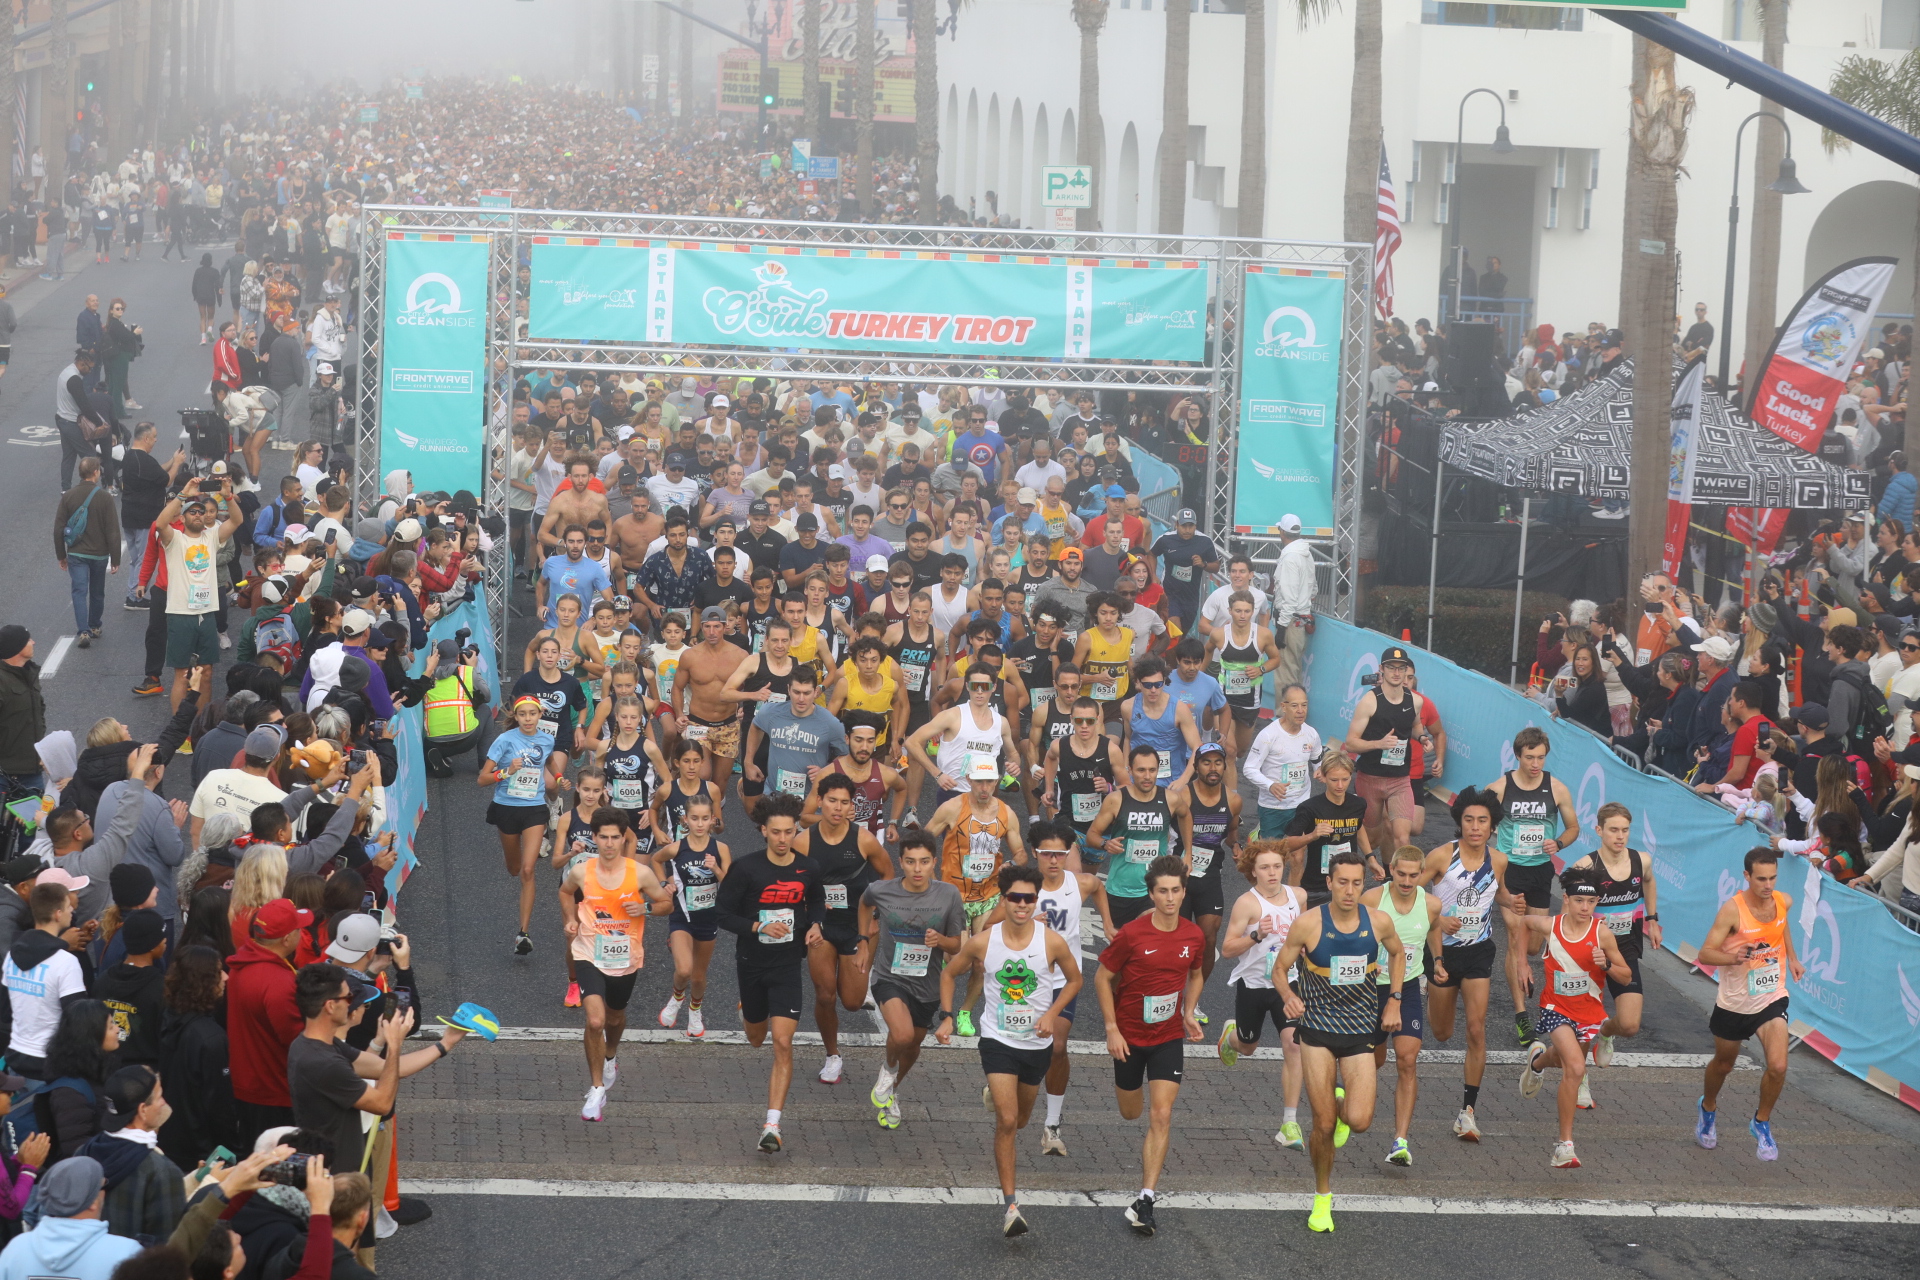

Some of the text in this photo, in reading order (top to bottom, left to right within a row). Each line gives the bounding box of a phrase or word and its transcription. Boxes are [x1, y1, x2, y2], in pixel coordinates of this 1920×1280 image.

[723, 72, 739, 81] DEC
[654, 253, 668, 338] START
[1072, 271, 1086, 354] START
[396, 316, 476, 328] OCEANSIDE
[828, 311, 950, 339] TURKEY
[953, 316, 1034, 343] TROT
[1254, 347, 1330, 362] OCEANSIDE
[395, 374, 470, 384] FRONTWAVE
[1776, 380, 1826, 411] Good
[1253, 405, 1322, 418] FRONTWAVE
[1766, 394, 1818, 430] Luck,
[1766, 414, 1807, 443] Turkey
[434, 438, 457, 446] DIEGO
[1824, 445, 1845, 454] SECURITY
[1276, 467, 1310, 476] SAN DIEGO
[1275, 474, 1308, 482] RUNNING
[1230, 677, 1250, 685] 6027
[771, 728, 819, 745] CAL POLY
[966, 741, 976, 750] CAL
[609, 758, 620, 766] SAN
[516, 776, 538, 785] 4874
[782, 779, 804, 789] 6156
[619, 788, 641, 796] 6004
[232, 793, 249, 804] TURKEY
[1079, 800, 1100, 810] 5205
[1348, 817, 1359, 827] VIEW
[1192, 823, 1227, 833] MILESTONE
[570, 831, 582, 840] SAN
[1520, 833, 1543, 843] 6609
[1133, 848, 1157, 857] 4940
[681, 861, 694, 870] SAN
[970, 862, 993, 871] 4679
[694, 893, 717, 902] 4896
[1609, 920, 1631, 930] 2355
[603, 945, 628, 954] 5402
[902, 953, 928, 962] 2939
[1340, 965, 1366, 976] 2581
[1561, 980, 1588, 989] 4333
[1755, 973, 1780, 986] 6045
[1152, 1001, 1176, 1014] 4923
[1006, 1015, 1032, 1024] 5961
